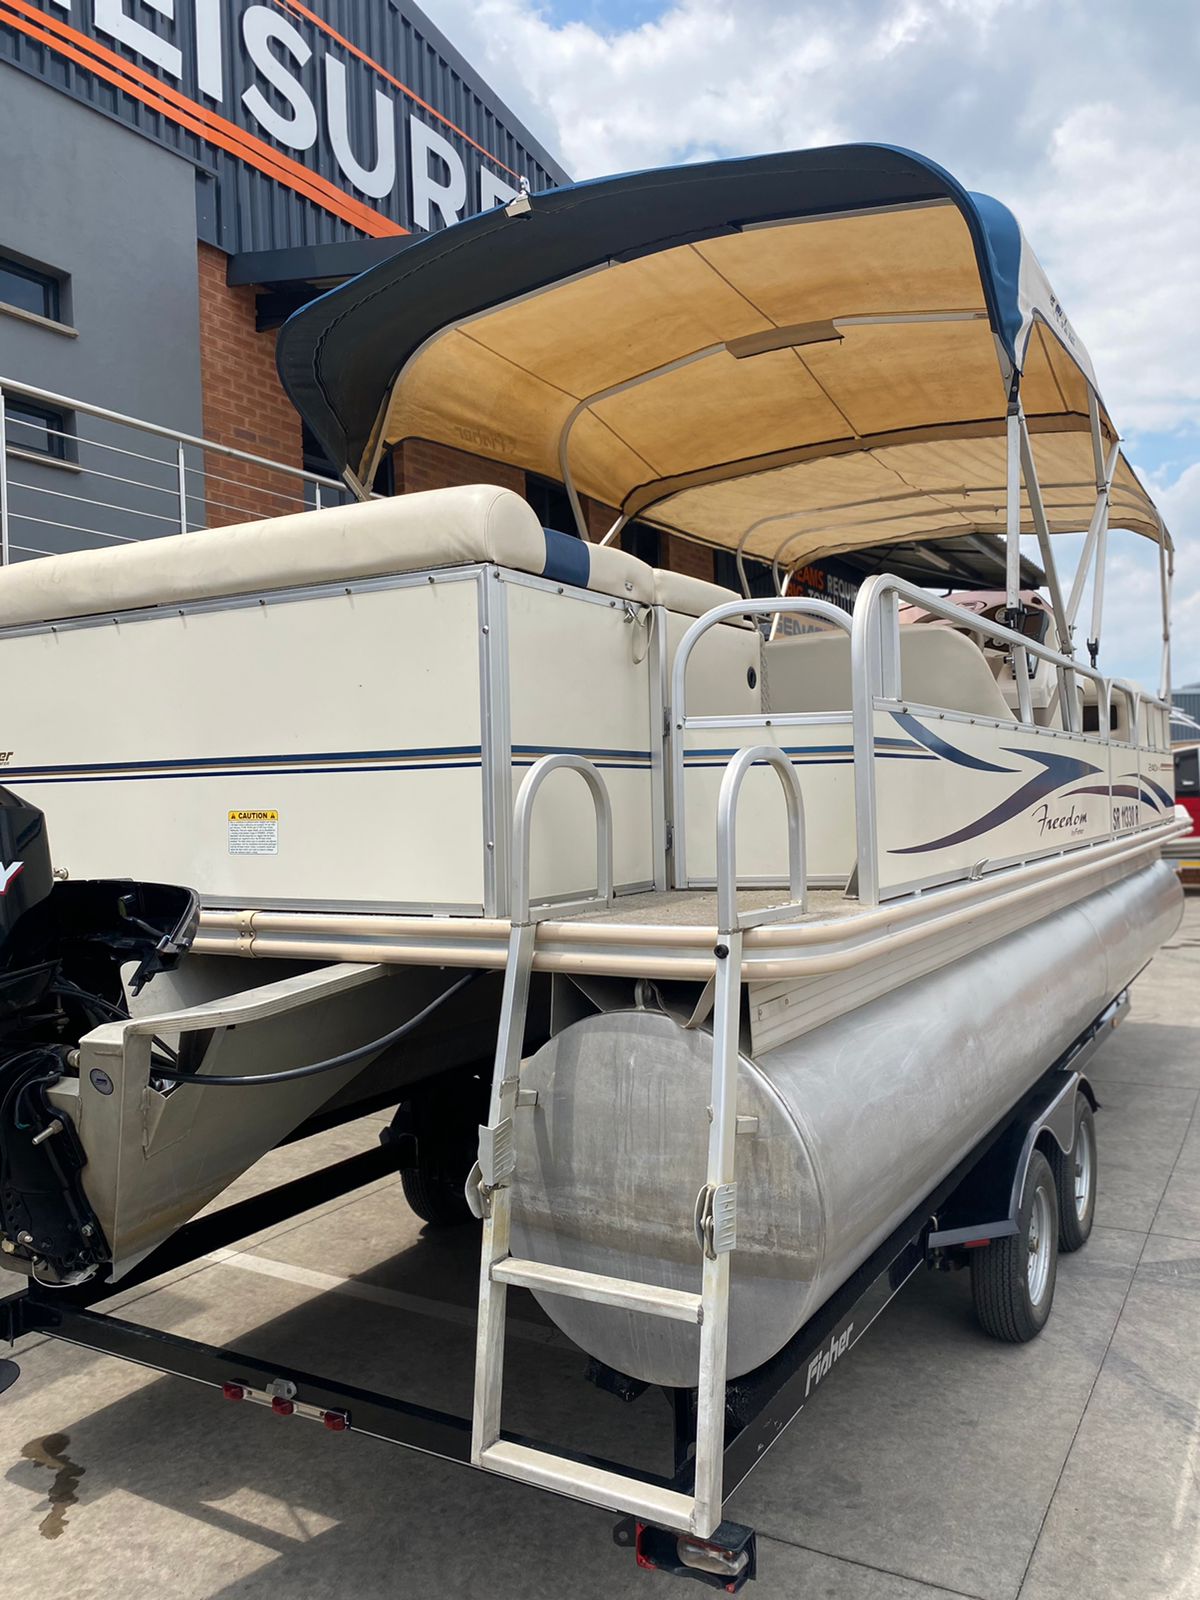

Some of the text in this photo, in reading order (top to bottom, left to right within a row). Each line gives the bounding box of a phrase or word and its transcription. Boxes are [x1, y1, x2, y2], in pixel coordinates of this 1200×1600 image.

[54, 0, 520, 231] ISUR
[1031, 803, 1088, 837] Freedom
[1113, 807, 1120, 830] SR
